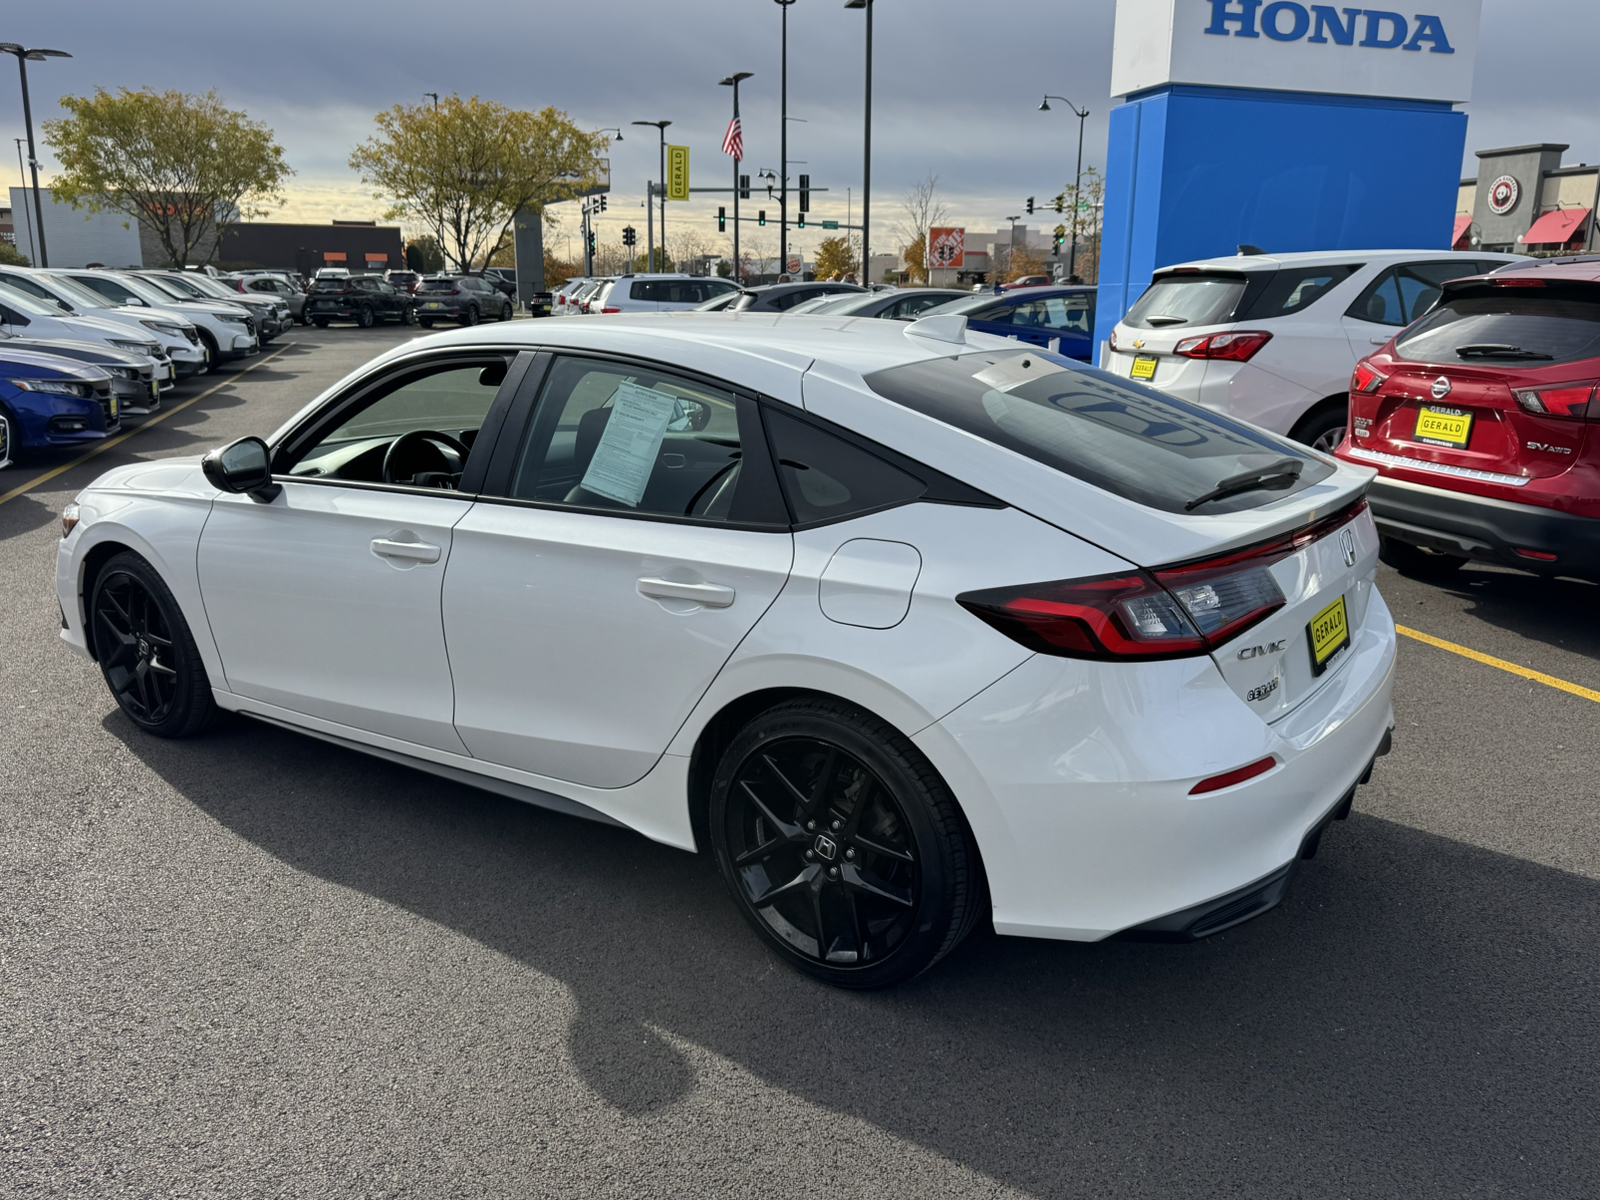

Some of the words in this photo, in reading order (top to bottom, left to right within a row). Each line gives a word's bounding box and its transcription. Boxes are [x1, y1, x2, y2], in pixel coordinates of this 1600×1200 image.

[1204, 0, 1455, 54] HONDA
[674, 152, 683, 194] GERALD
[1430, 405, 1461, 416] GERALD
[1423, 420, 1461, 433] GERALD
[1526, 441, 1549, 451] SV
[1547, 445, 1572, 455] AWD
[1315, 610, 1343, 643] GERALD
[1237, 639, 1286, 660] CIVIC
[1246, 677, 1279, 702] GERALD
